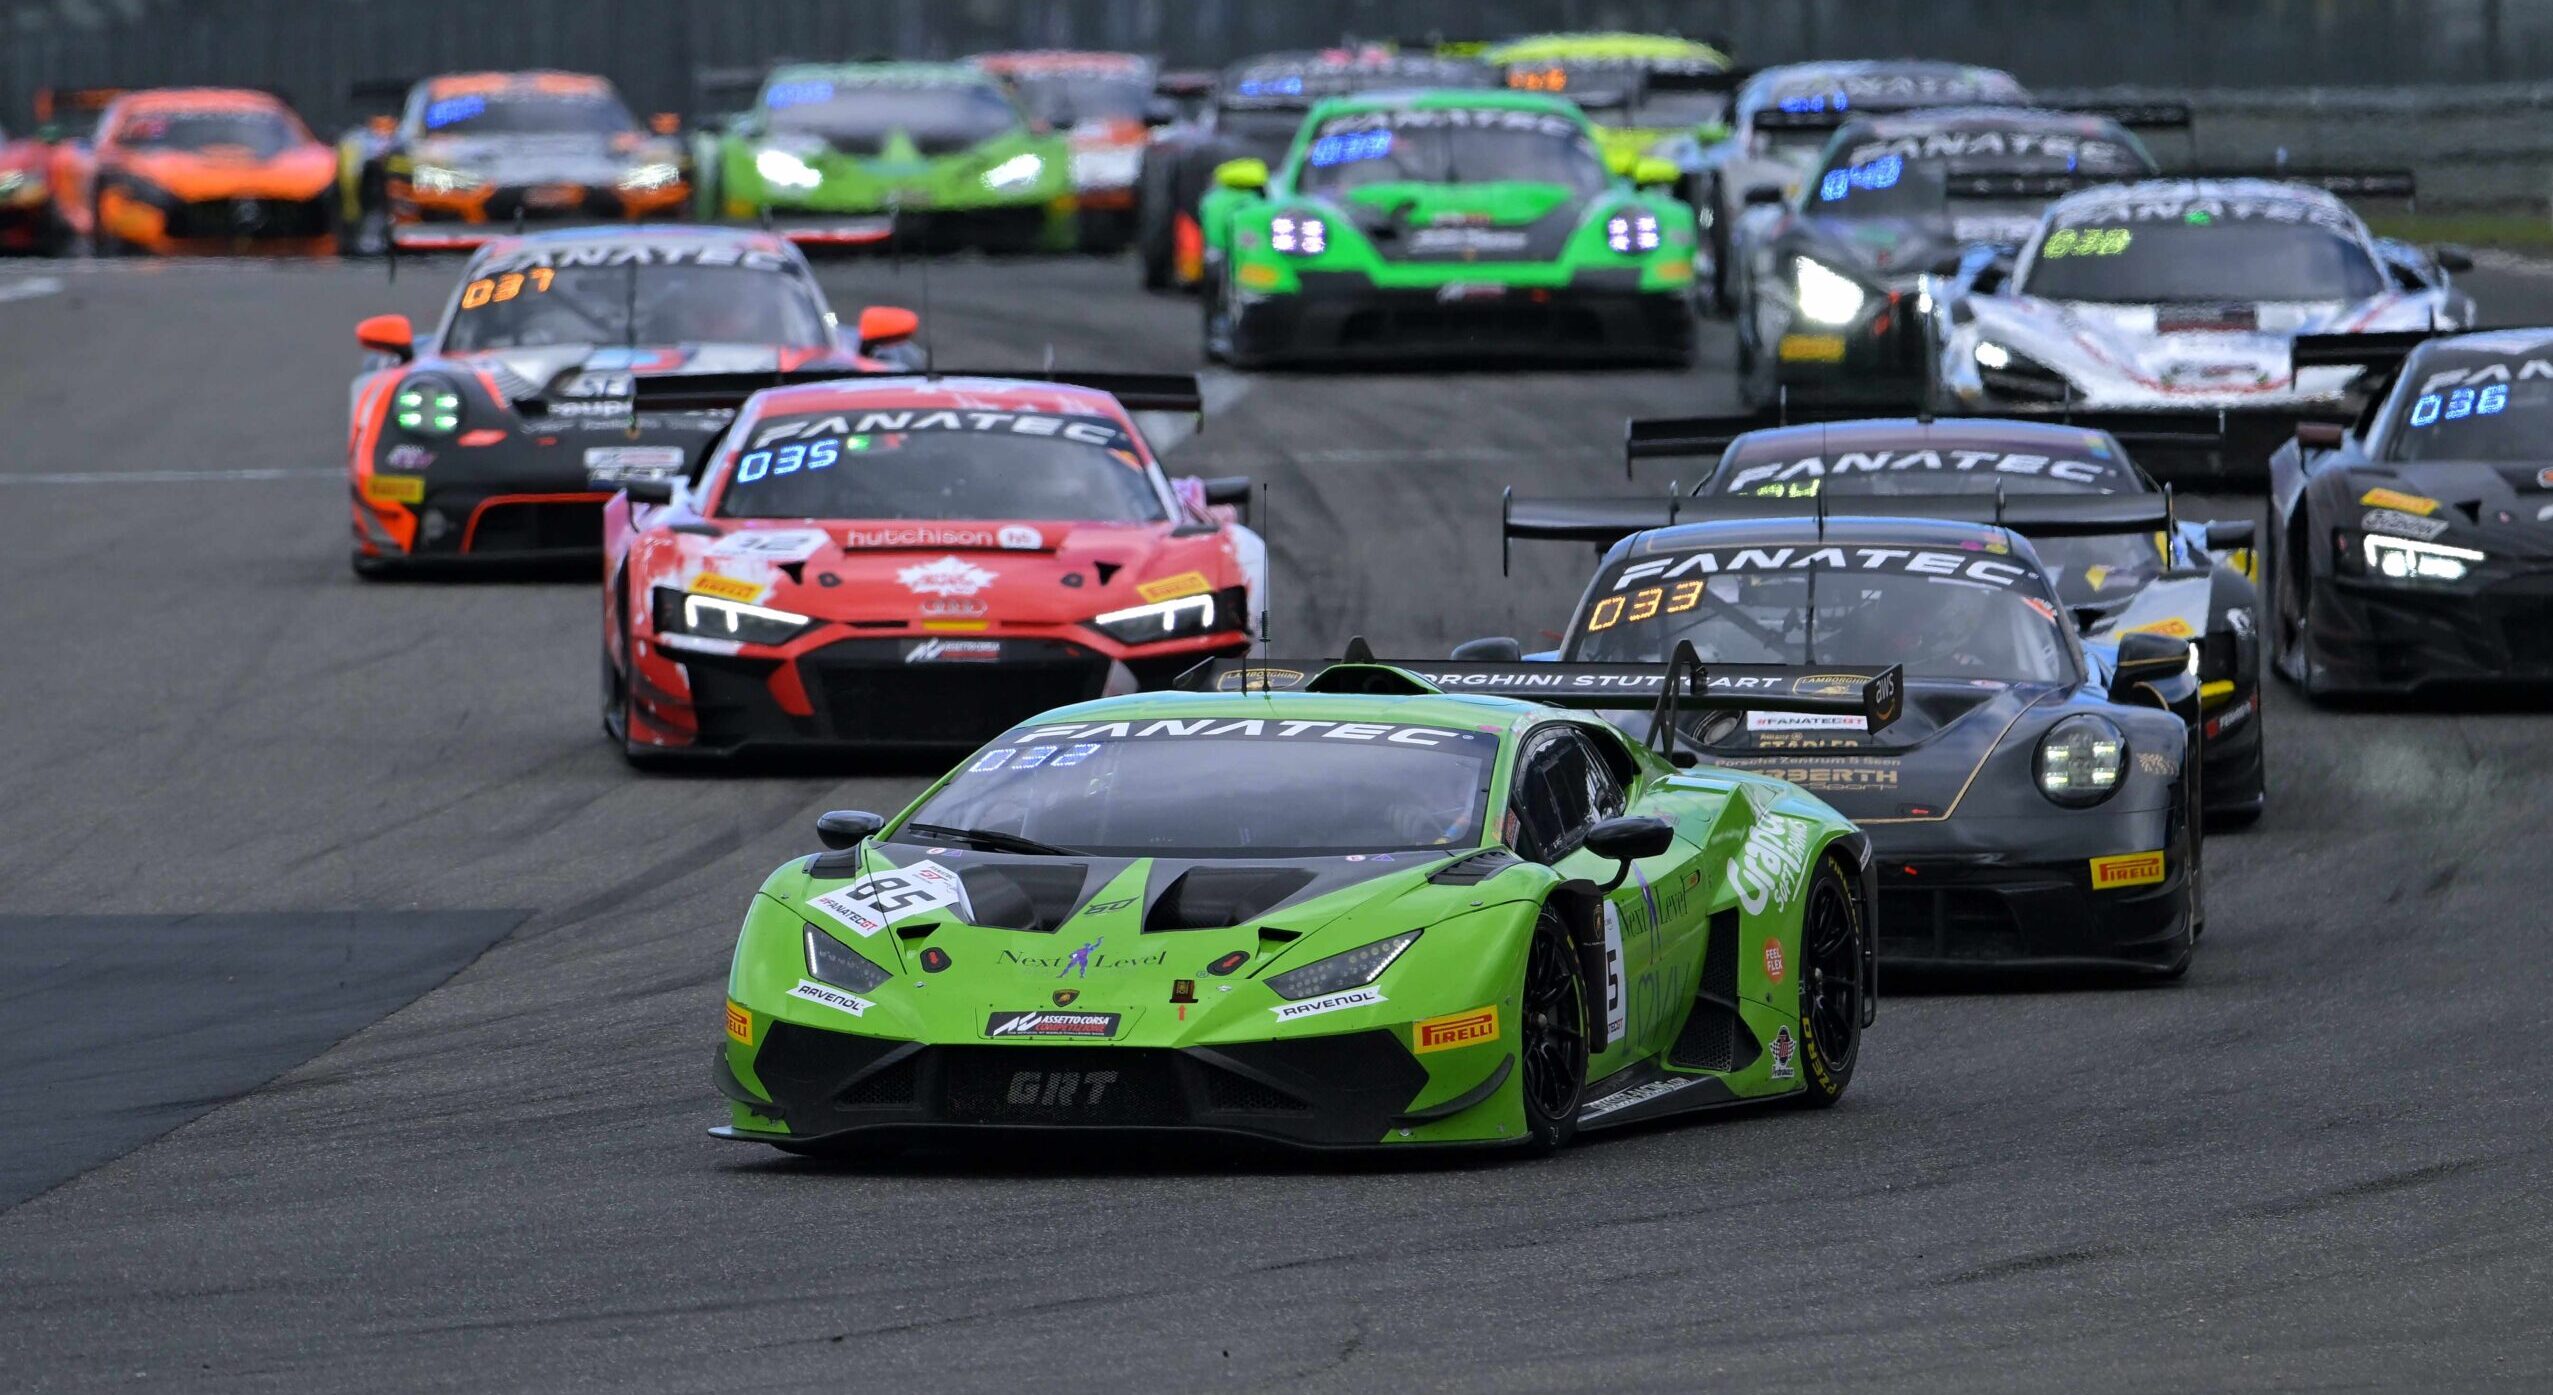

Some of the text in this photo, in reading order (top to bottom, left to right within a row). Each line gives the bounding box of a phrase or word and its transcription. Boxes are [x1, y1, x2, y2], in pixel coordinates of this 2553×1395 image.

[461, 266, 556, 311] 037
[2409, 383, 2509, 428] 036
[753, 410, 1118, 450] FANATEC
[736, 438, 839, 485] 035
[1728, 450, 2103, 494] FANATEC
[847, 527, 993, 547] hutchison
[1613, 547, 2027, 591] FANATEC
[1588, 579, 1704, 633] 033
[1572, 674, 1784, 689] STUTART
[1800, 676, 1868, 686] LAMBORGHI
[1875, 671, 1895, 704] aws
[1026, 719, 1461, 746] FANATEC
[967, 742, 1102, 773] 032
[1780, 756, 1844, 765] Zentrum
[1753, 768, 1899, 784] RBERTH
[2099, 857, 2160, 883] PIRELLI
[845, 877, 938, 914] 85
[817, 896, 880, 932] #FANATECGT
[996, 949, 1168, 969] Next Level
[1765, 948, 1782, 960] FEEL
[1766, 958, 1784, 972] FLEX
[1605, 948, 1619, 1012] 5
[798, 984, 860, 1012] RAVENOL
[1282, 992, 1376, 1017] RAVENOL
[1041, 1014, 1111, 1026] ASSETTO CORSA
[1421, 1013, 1493, 1047] PIRELLI
